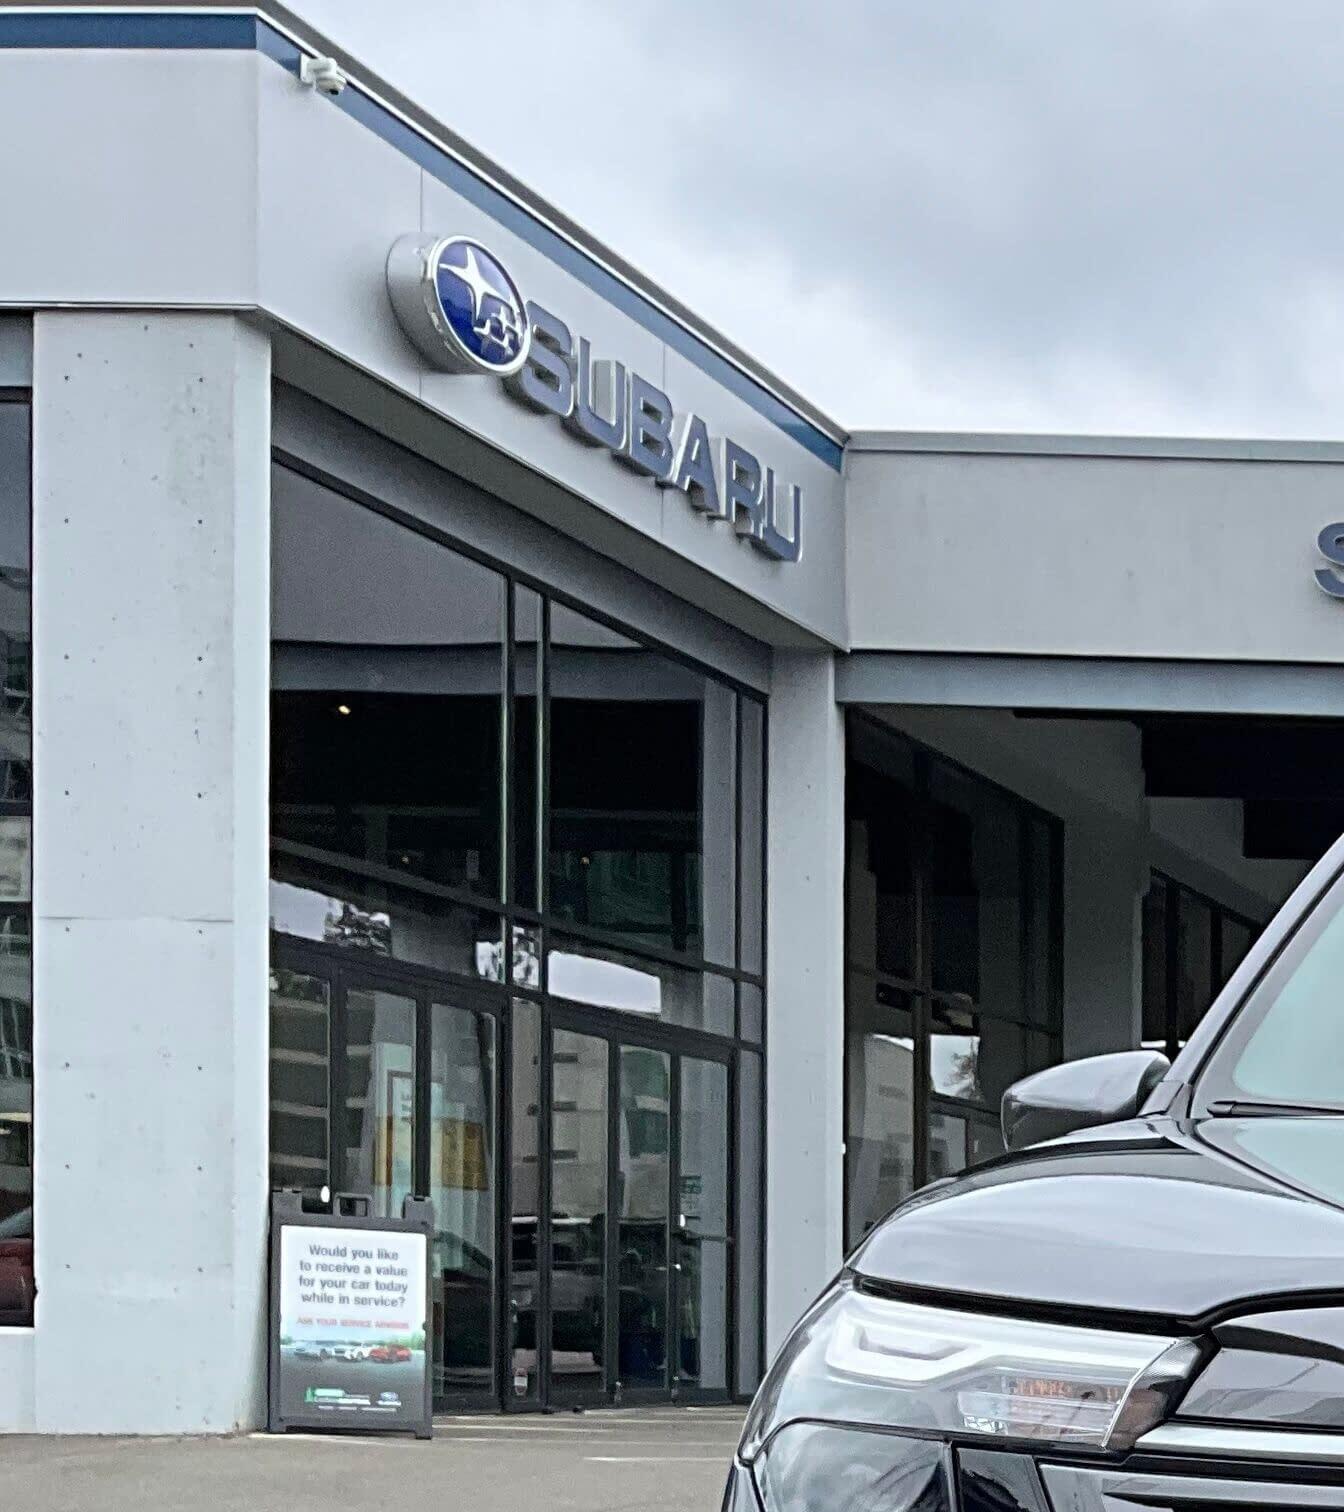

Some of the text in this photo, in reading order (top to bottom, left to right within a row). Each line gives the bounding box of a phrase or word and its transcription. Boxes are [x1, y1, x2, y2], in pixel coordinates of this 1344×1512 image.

[520, 299, 804, 563] SUBARU
[309, 1245, 399, 1260] Would you like
[299, 1260, 408, 1276] to receive a value
[299, 1275, 408, 1294] for your car today
[301, 1293, 406, 1307] while in service?
